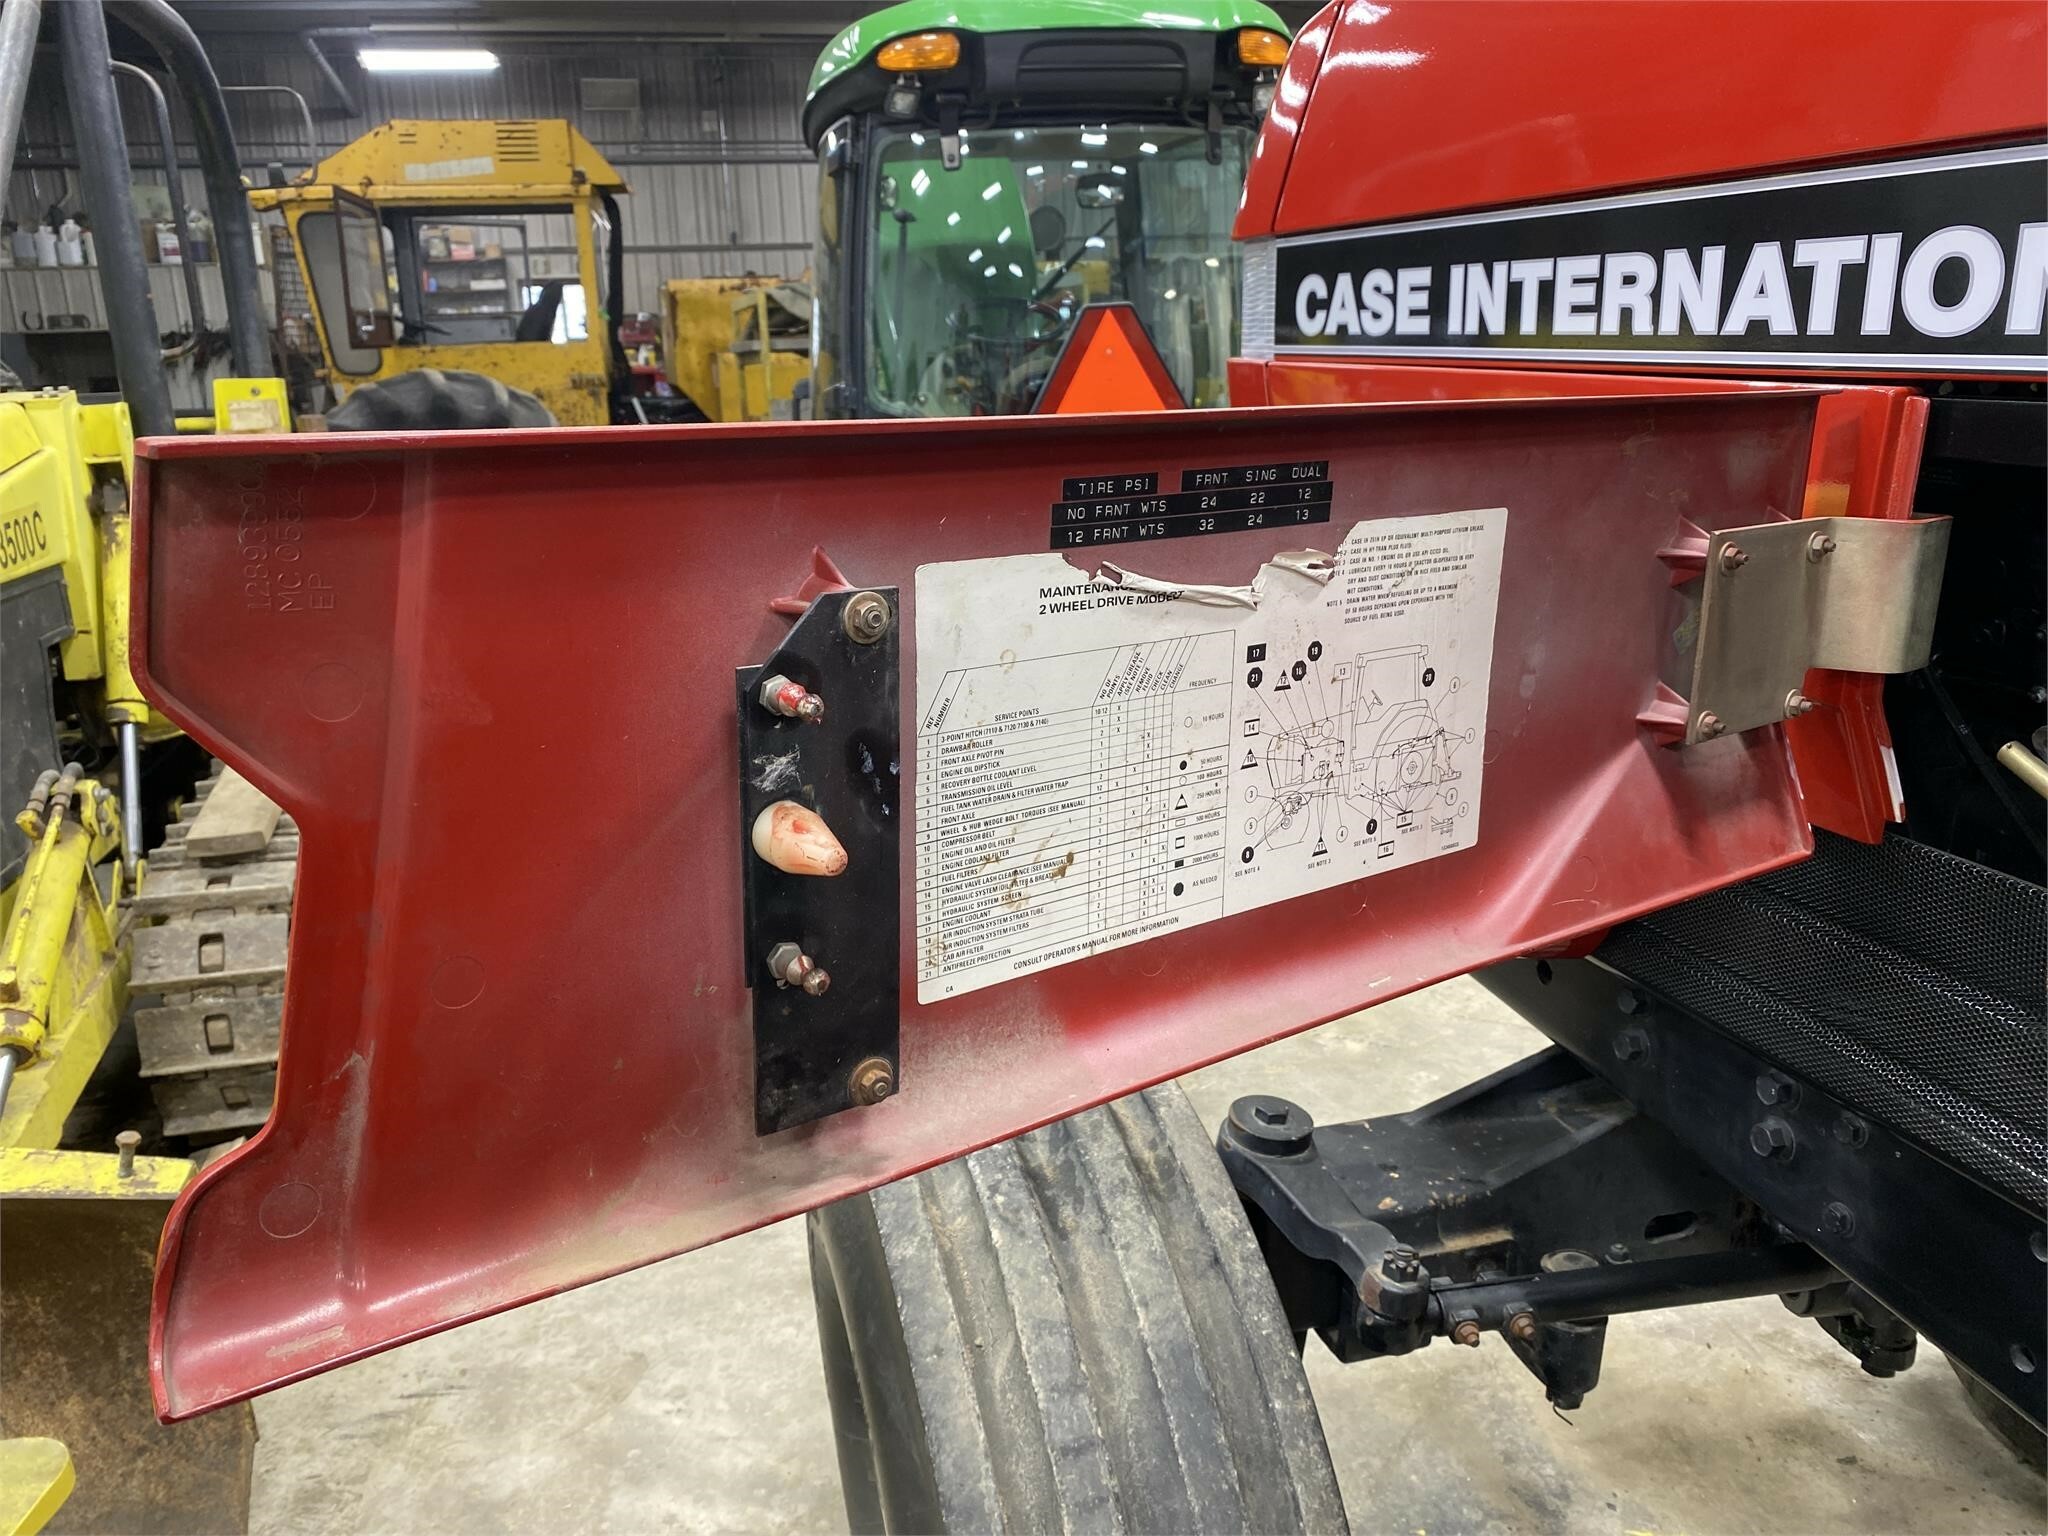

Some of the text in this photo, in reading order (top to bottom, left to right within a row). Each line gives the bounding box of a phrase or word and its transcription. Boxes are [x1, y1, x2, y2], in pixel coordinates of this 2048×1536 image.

[1295, 264, 1433, 338] CASE
[1079, 478, 1149, 495] TIRE PSI
[1196, 467, 1321, 486] FRNT SING DUAL
[1067, 488, 1312, 520] NO FRNT WTS 24 22 12
[1068, 509, 1309, 543] 12 FRNT WTS 32 24 13
[277, 571, 303, 613] MC
[308, 573, 334, 609] EP
[1039, 582, 1137, 599] MAINTENANC
[1039, 604, 1046, 615] 2
[1049, 599, 1094, 614] WHEEL
[1097, 595, 1135, 608] DRIVE
[1252, 648, 1260, 658] 17
[1105, 679, 1112, 688] OF
[1117, 651, 1141, 697] APPLY GREASE
[1131, 666, 1141, 681] NOTE
[1135, 666, 1151, 693] REMOVE
[1142, 673, 1154, 692] FLUID
[1151, 671, 1164, 692] CHECK
[1160, 670, 1173, 691] CLEAN
[1169, 664, 1184, 689] CHANGE
[1189, 678, 1217, 688] FREQUENCY
[1251, 673, 1259, 683] 21
[1106, 675, 1121, 698] POINTS
[933, 697, 951, 728] NUMBER
[995, 707, 1040, 722] SERVICE POINTS
[925, 717, 935, 730] REF
[965, 729, 983, 739] HITCH
[1004, 723, 1016, 733] 7120
[1017, 721, 1029, 730] 7130
[1248, 723, 1255, 732] 14
[941, 739, 993, 755] DRAWBAR ROLLER
[941, 748, 1005, 767] FRONT AXLE PIVOT PIN
[941, 761, 1001, 779] ENGINE OIL DIPSTICK
[941, 765, 1037, 790] RECOVERY BOTTLE COOLANT LEVEL
[941, 781, 1013, 801] TRANSMISSION OIL LEVEL
[941, 781, 1069, 813] FUEL TANK WATER DRAIN & FILTER WATER TRAP
[941, 811, 976, 825] FRONT AXLE
[941, 826, 960, 837] WHEEL
[962, 824, 968, 833] &
[969, 821, 982, 831] HUB
[983, 817, 1003, 828] WEDGE
[1005, 813, 1019, 824] BOLT
[1021, 808, 1046, 820] TORQUES
[1047, 805, 1060, 815] (SEE
[941, 830, 995, 848] COMPRESSOR BELT
[1203, 830, 1220, 839] HOURS
[941, 837, 1016, 860] ENGINE OIL AND OIL FILTER
[1202, 852, 1219, 862] HOURS
[941, 849, 1010, 871] ENGINE COOLANT FILTER
[941, 868, 978, 883] FUEL FILTERS
[941, 882, 963, 895] ENGINE
[964, 878, 982, 889] VALVE
[982, 874, 997, 885] LASH
[998, 866, 1030, 881] CLEARANCE
[1192, 875, 1218, 888] AS NEEDED
[941, 892, 974, 907] HYDRAULIC
[975, 886, 998, 899] SYSTEM
[1029, 877, 1034, 885] &
[941, 891, 1022, 918] HYDRAULIC SYSTEM SCREEN
[942, 910, 991, 929] ENGINE COOLANT
[942, 907, 1044, 940] AIR INDUCTION SYSTEM STRATA TUBE
[943, 921, 1030, 951] AIR INDUCTION SYSTEM FILTERS
[1013, 954, 1042, 970] CONSULT
[1081, 935, 1108, 951] MANUAL
[1109, 932, 1121, 943] FOR
[1121, 927, 1139, 940] MORE
[1139, 915, 1179, 935] INFORMATION
[942, 944, 984, 962] CAB AIR FILTER
[942, 947, 1011, 973] ANTIFREEZE PROTECTION
